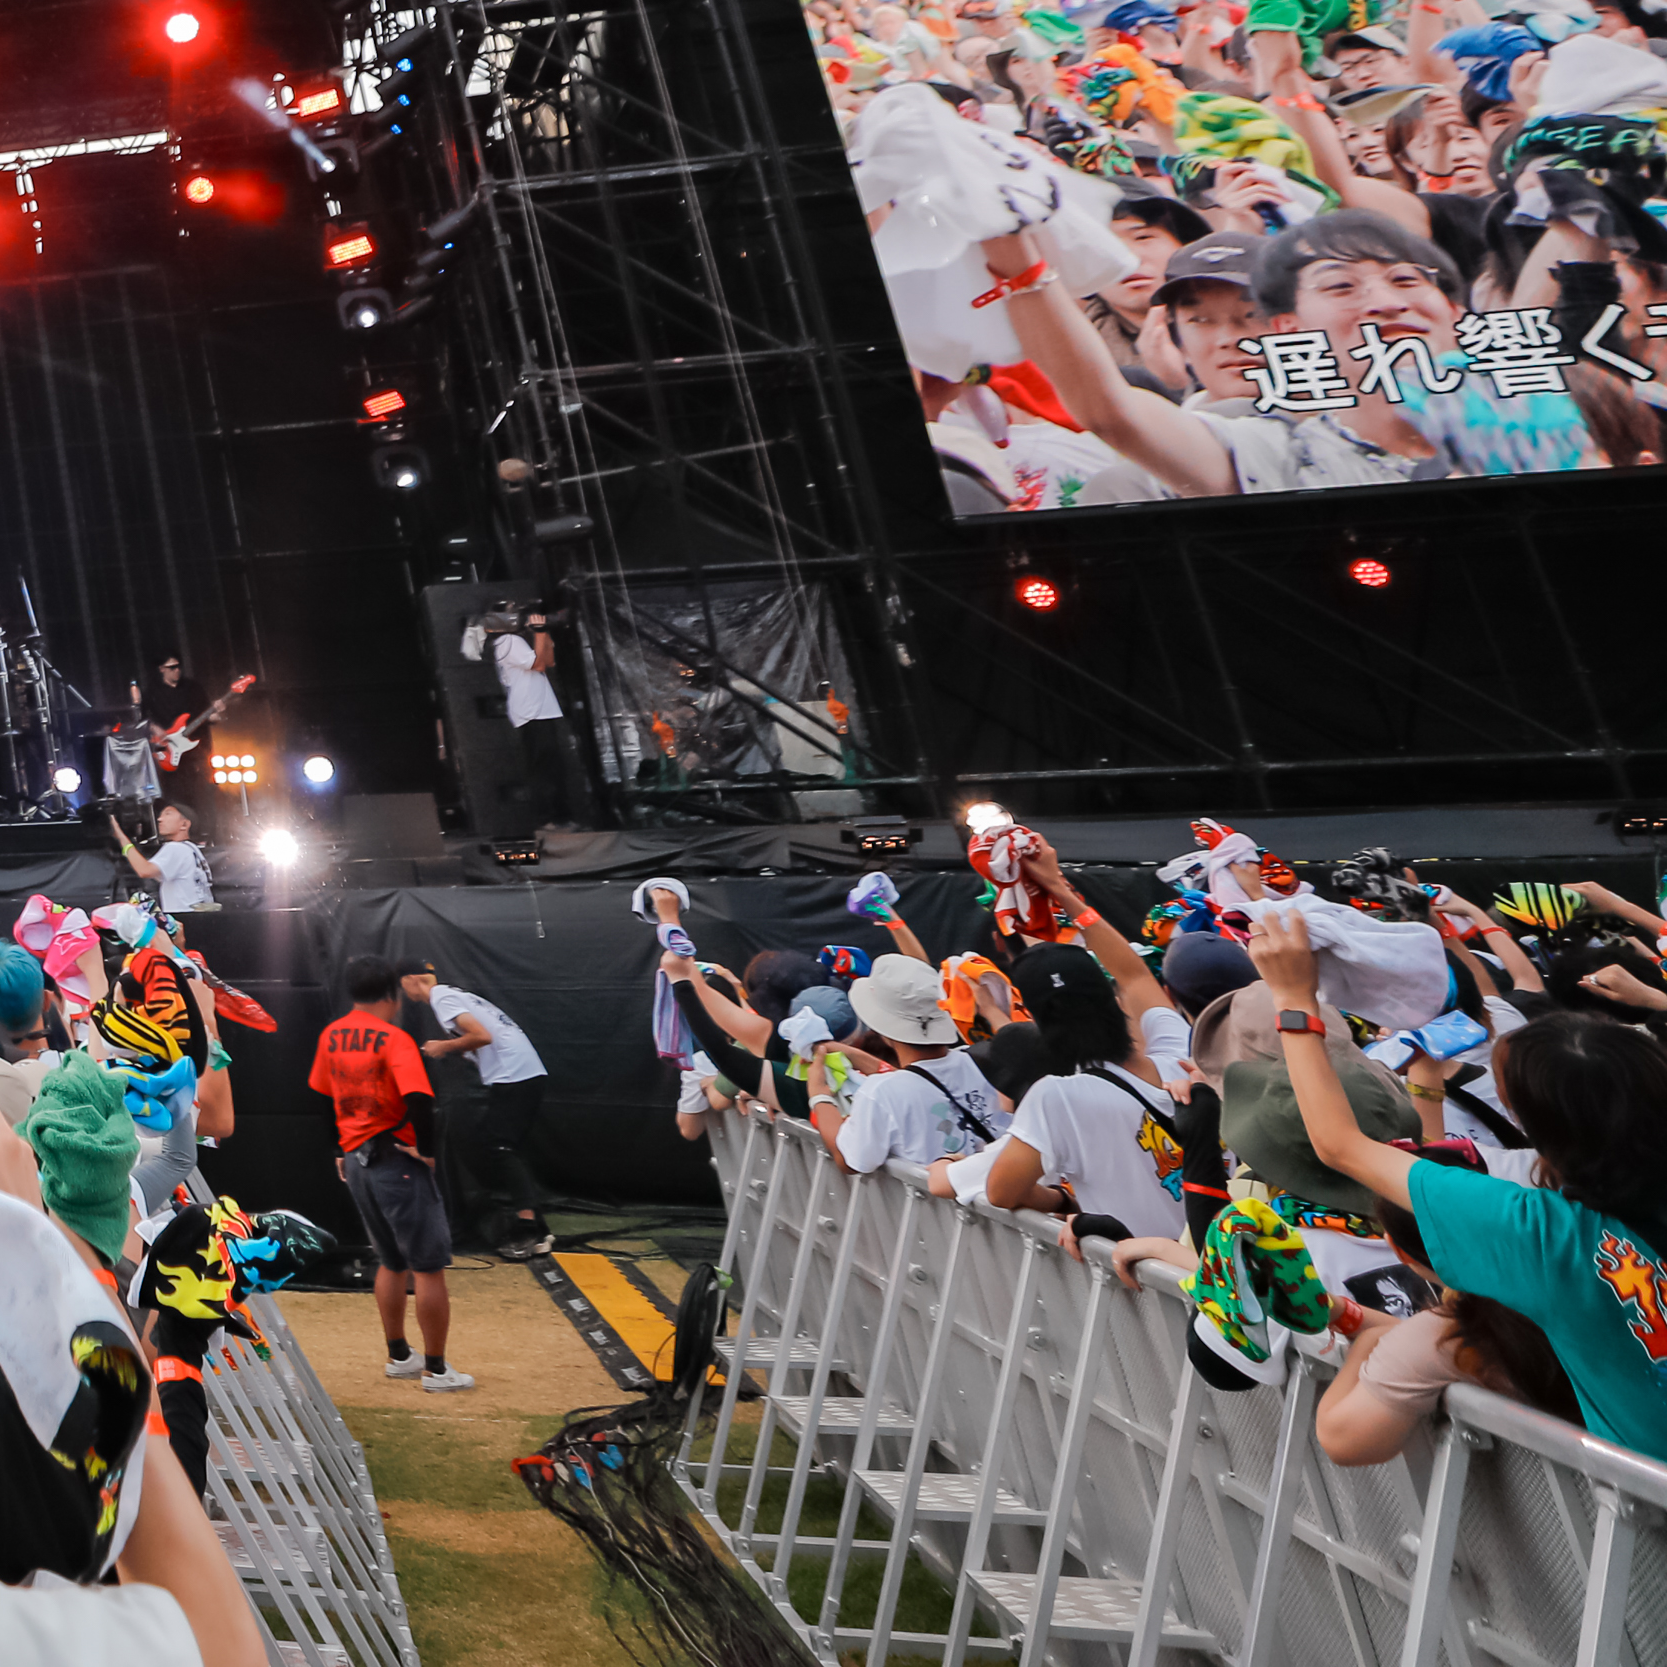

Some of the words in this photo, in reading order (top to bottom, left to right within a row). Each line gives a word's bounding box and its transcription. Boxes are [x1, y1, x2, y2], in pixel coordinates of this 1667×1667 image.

[1237, 302, 1667, 414] 遅れ響く
[328, 1028, 390, 1054] STAFF
